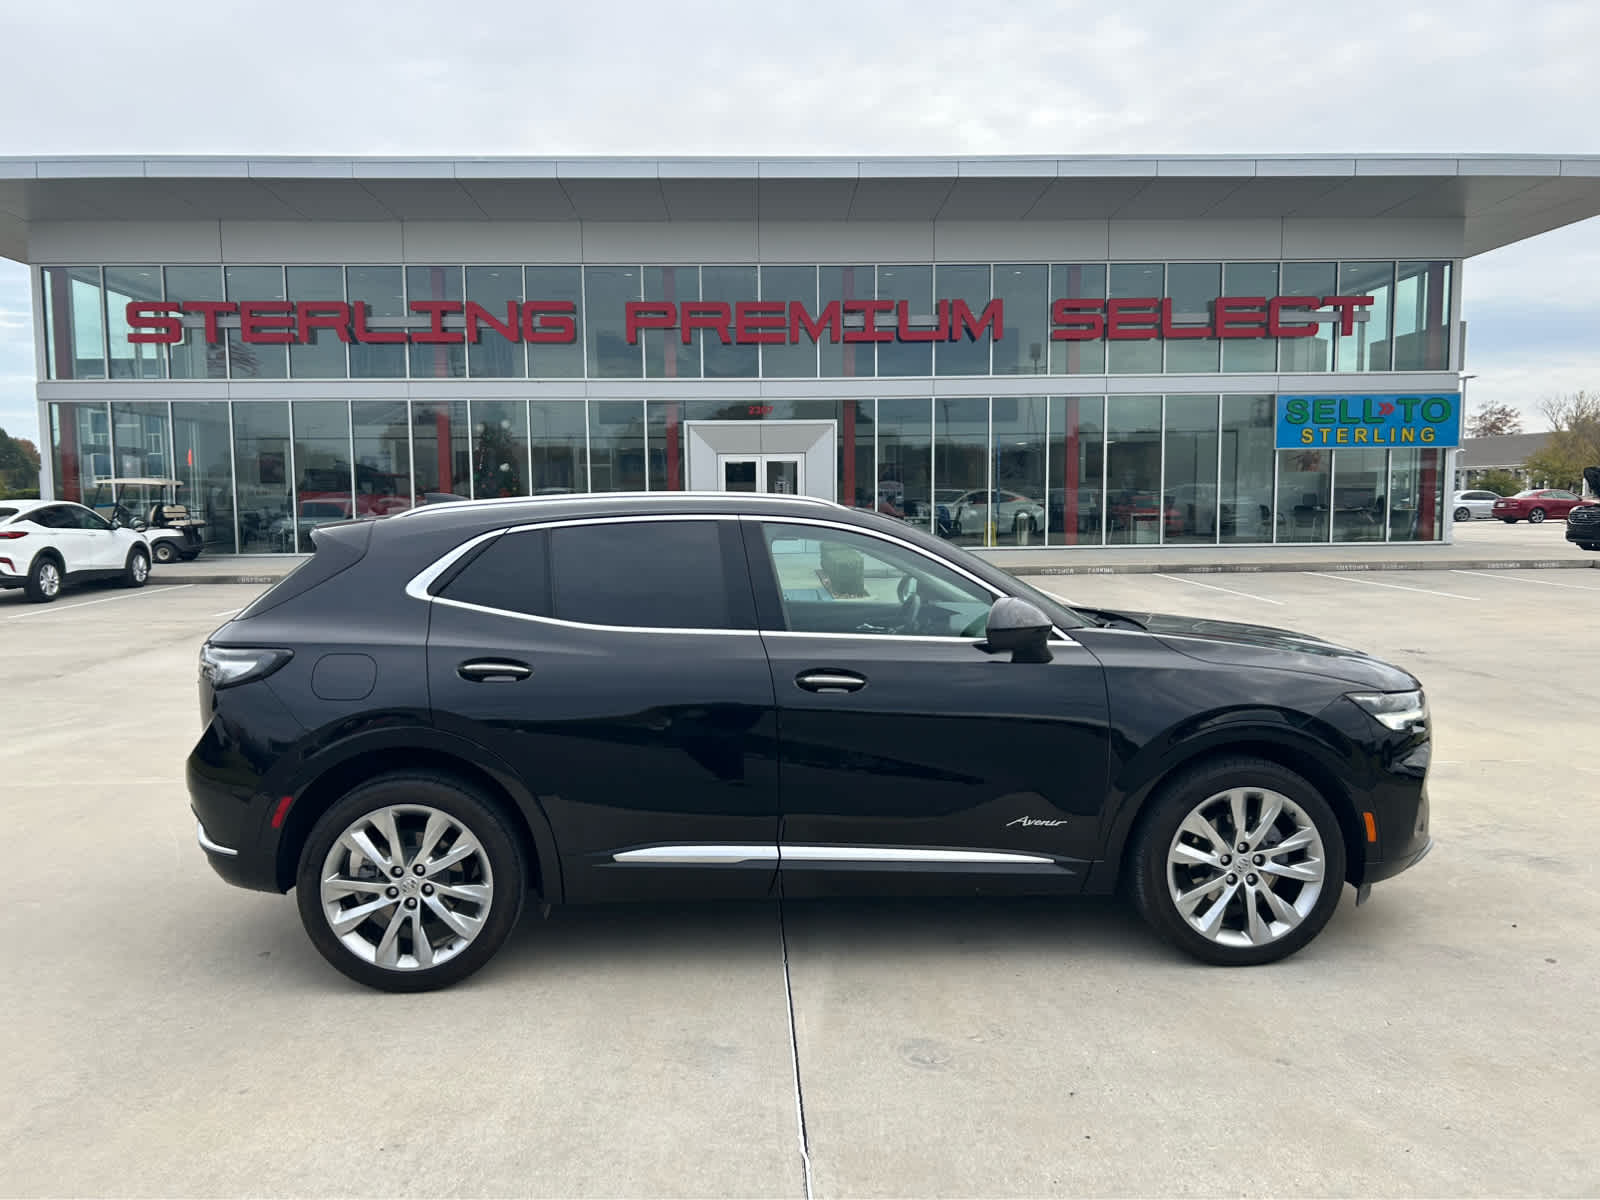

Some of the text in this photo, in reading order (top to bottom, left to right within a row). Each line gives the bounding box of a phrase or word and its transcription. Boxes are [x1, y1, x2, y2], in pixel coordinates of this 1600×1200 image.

[126, 296, 1375, 344] STERLING PREMIUM SELECT
[1285, 397, 1452, 424] SELL TO
[1301, 427, 1436, 443] STERLING
[1006, 815, 1068, 827] Avenir
